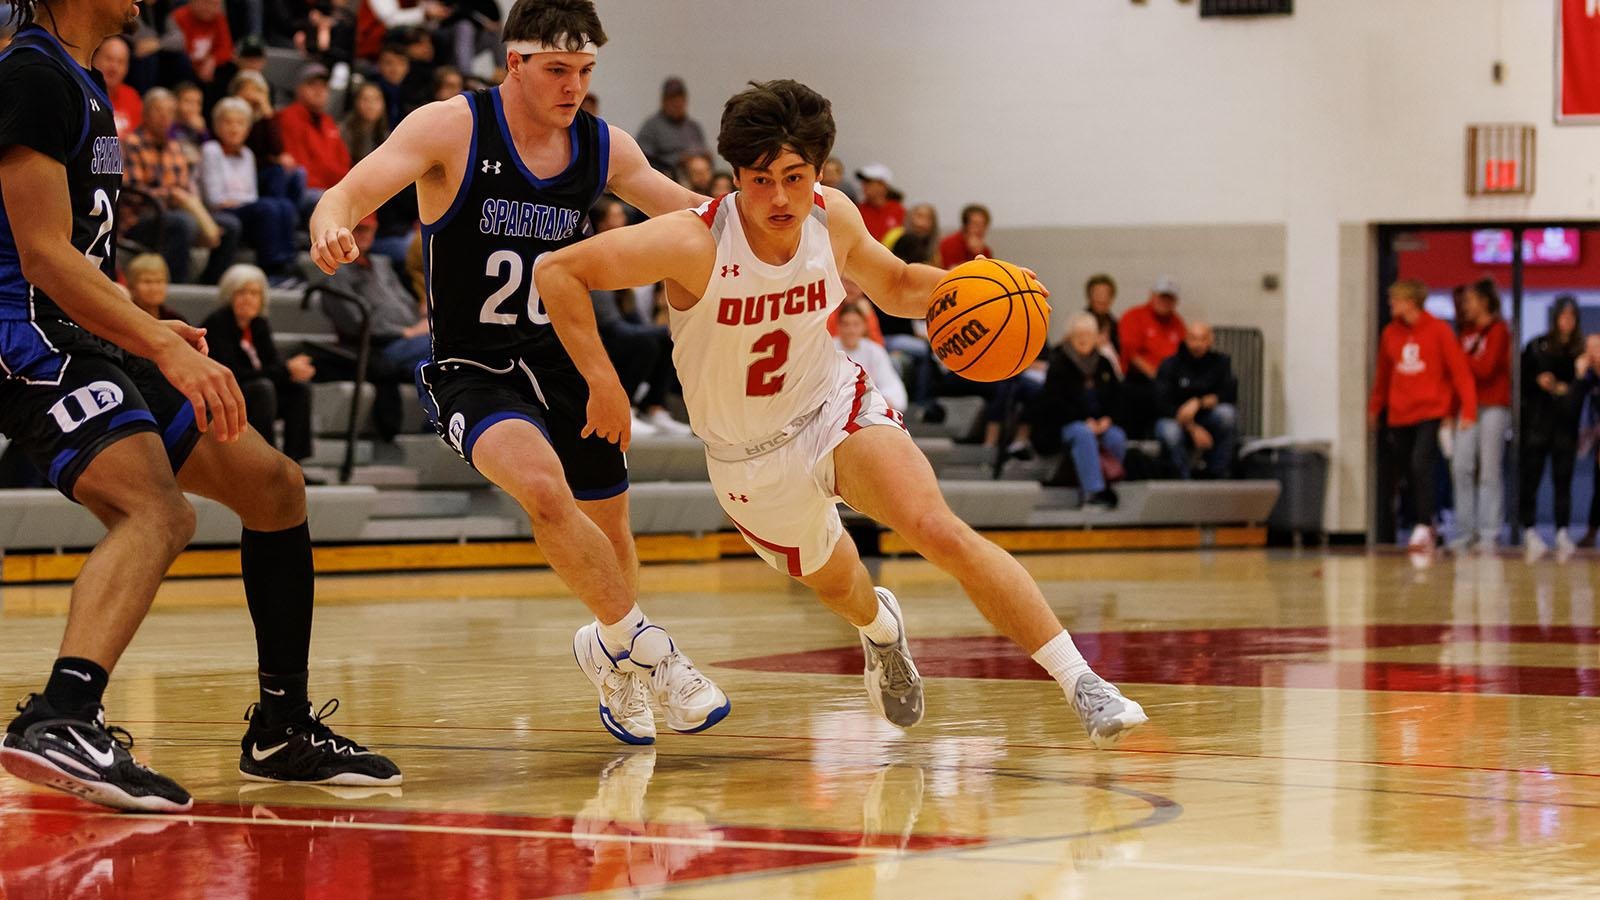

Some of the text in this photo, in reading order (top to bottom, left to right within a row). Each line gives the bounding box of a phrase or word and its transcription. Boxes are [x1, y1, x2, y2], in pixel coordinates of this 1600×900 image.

[85, 188, 120, 269] 2
[480, 198, 580, 240] SPARTANS
[716, 278, 827, 326] DUTCH
[745, 327, 792, 397] 2
